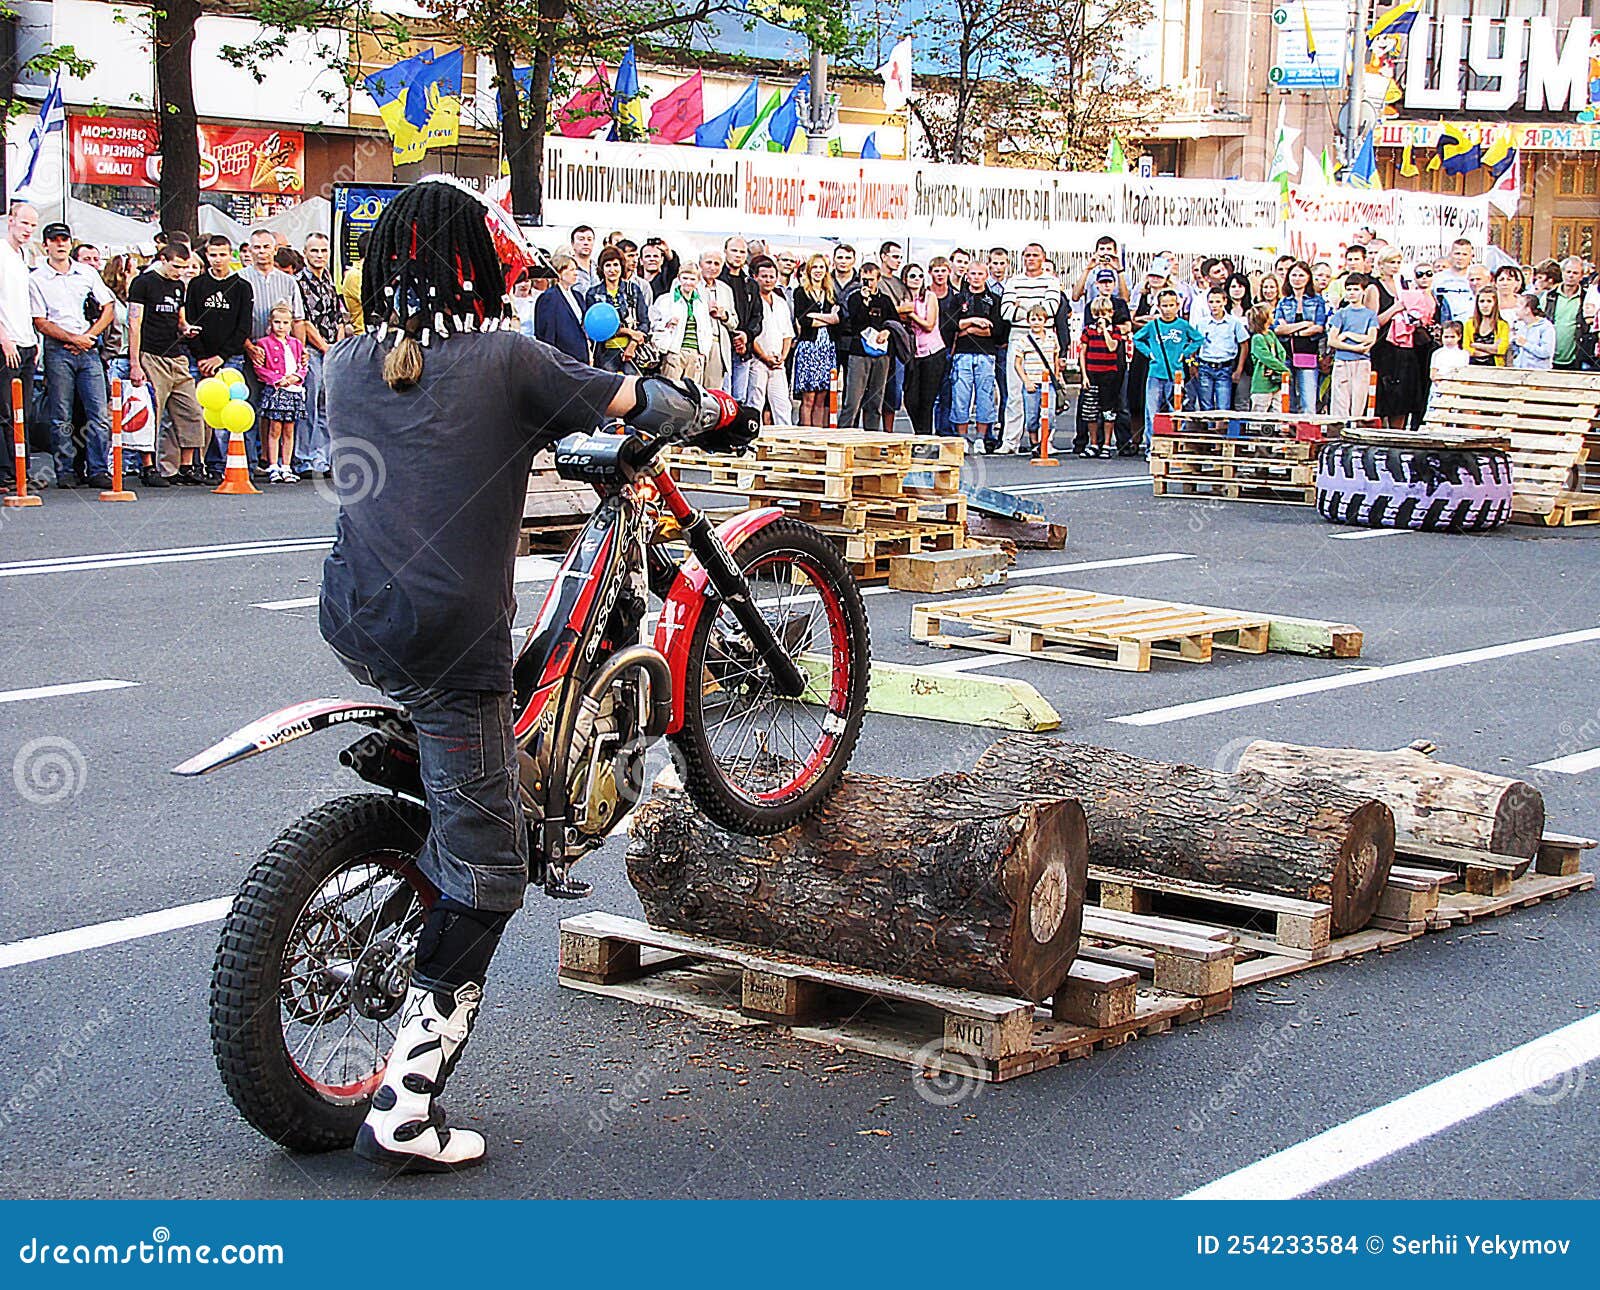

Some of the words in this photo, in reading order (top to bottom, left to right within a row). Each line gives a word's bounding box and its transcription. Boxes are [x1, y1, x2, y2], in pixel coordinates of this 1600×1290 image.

[1404, 14, 1592, 111] ЦУМ
[81, 125, 147, 141] МОРОЗИВО
[84, 142, 100, 156] НА
[102, 143, 145, 159] РІЗНИЙ
[547, 148, 563, 201] Ні
[566, 151, 655, 205] політичним
[659, 159, 738, 220] репресіям!
[744, 160, 773, 216] Наша
[1034, 178, 1050, 230] від
[557, 454, 592, 465] GAS
[583, 465, 616, 475] GAS
[267, 721, 310, 744] IPONE
